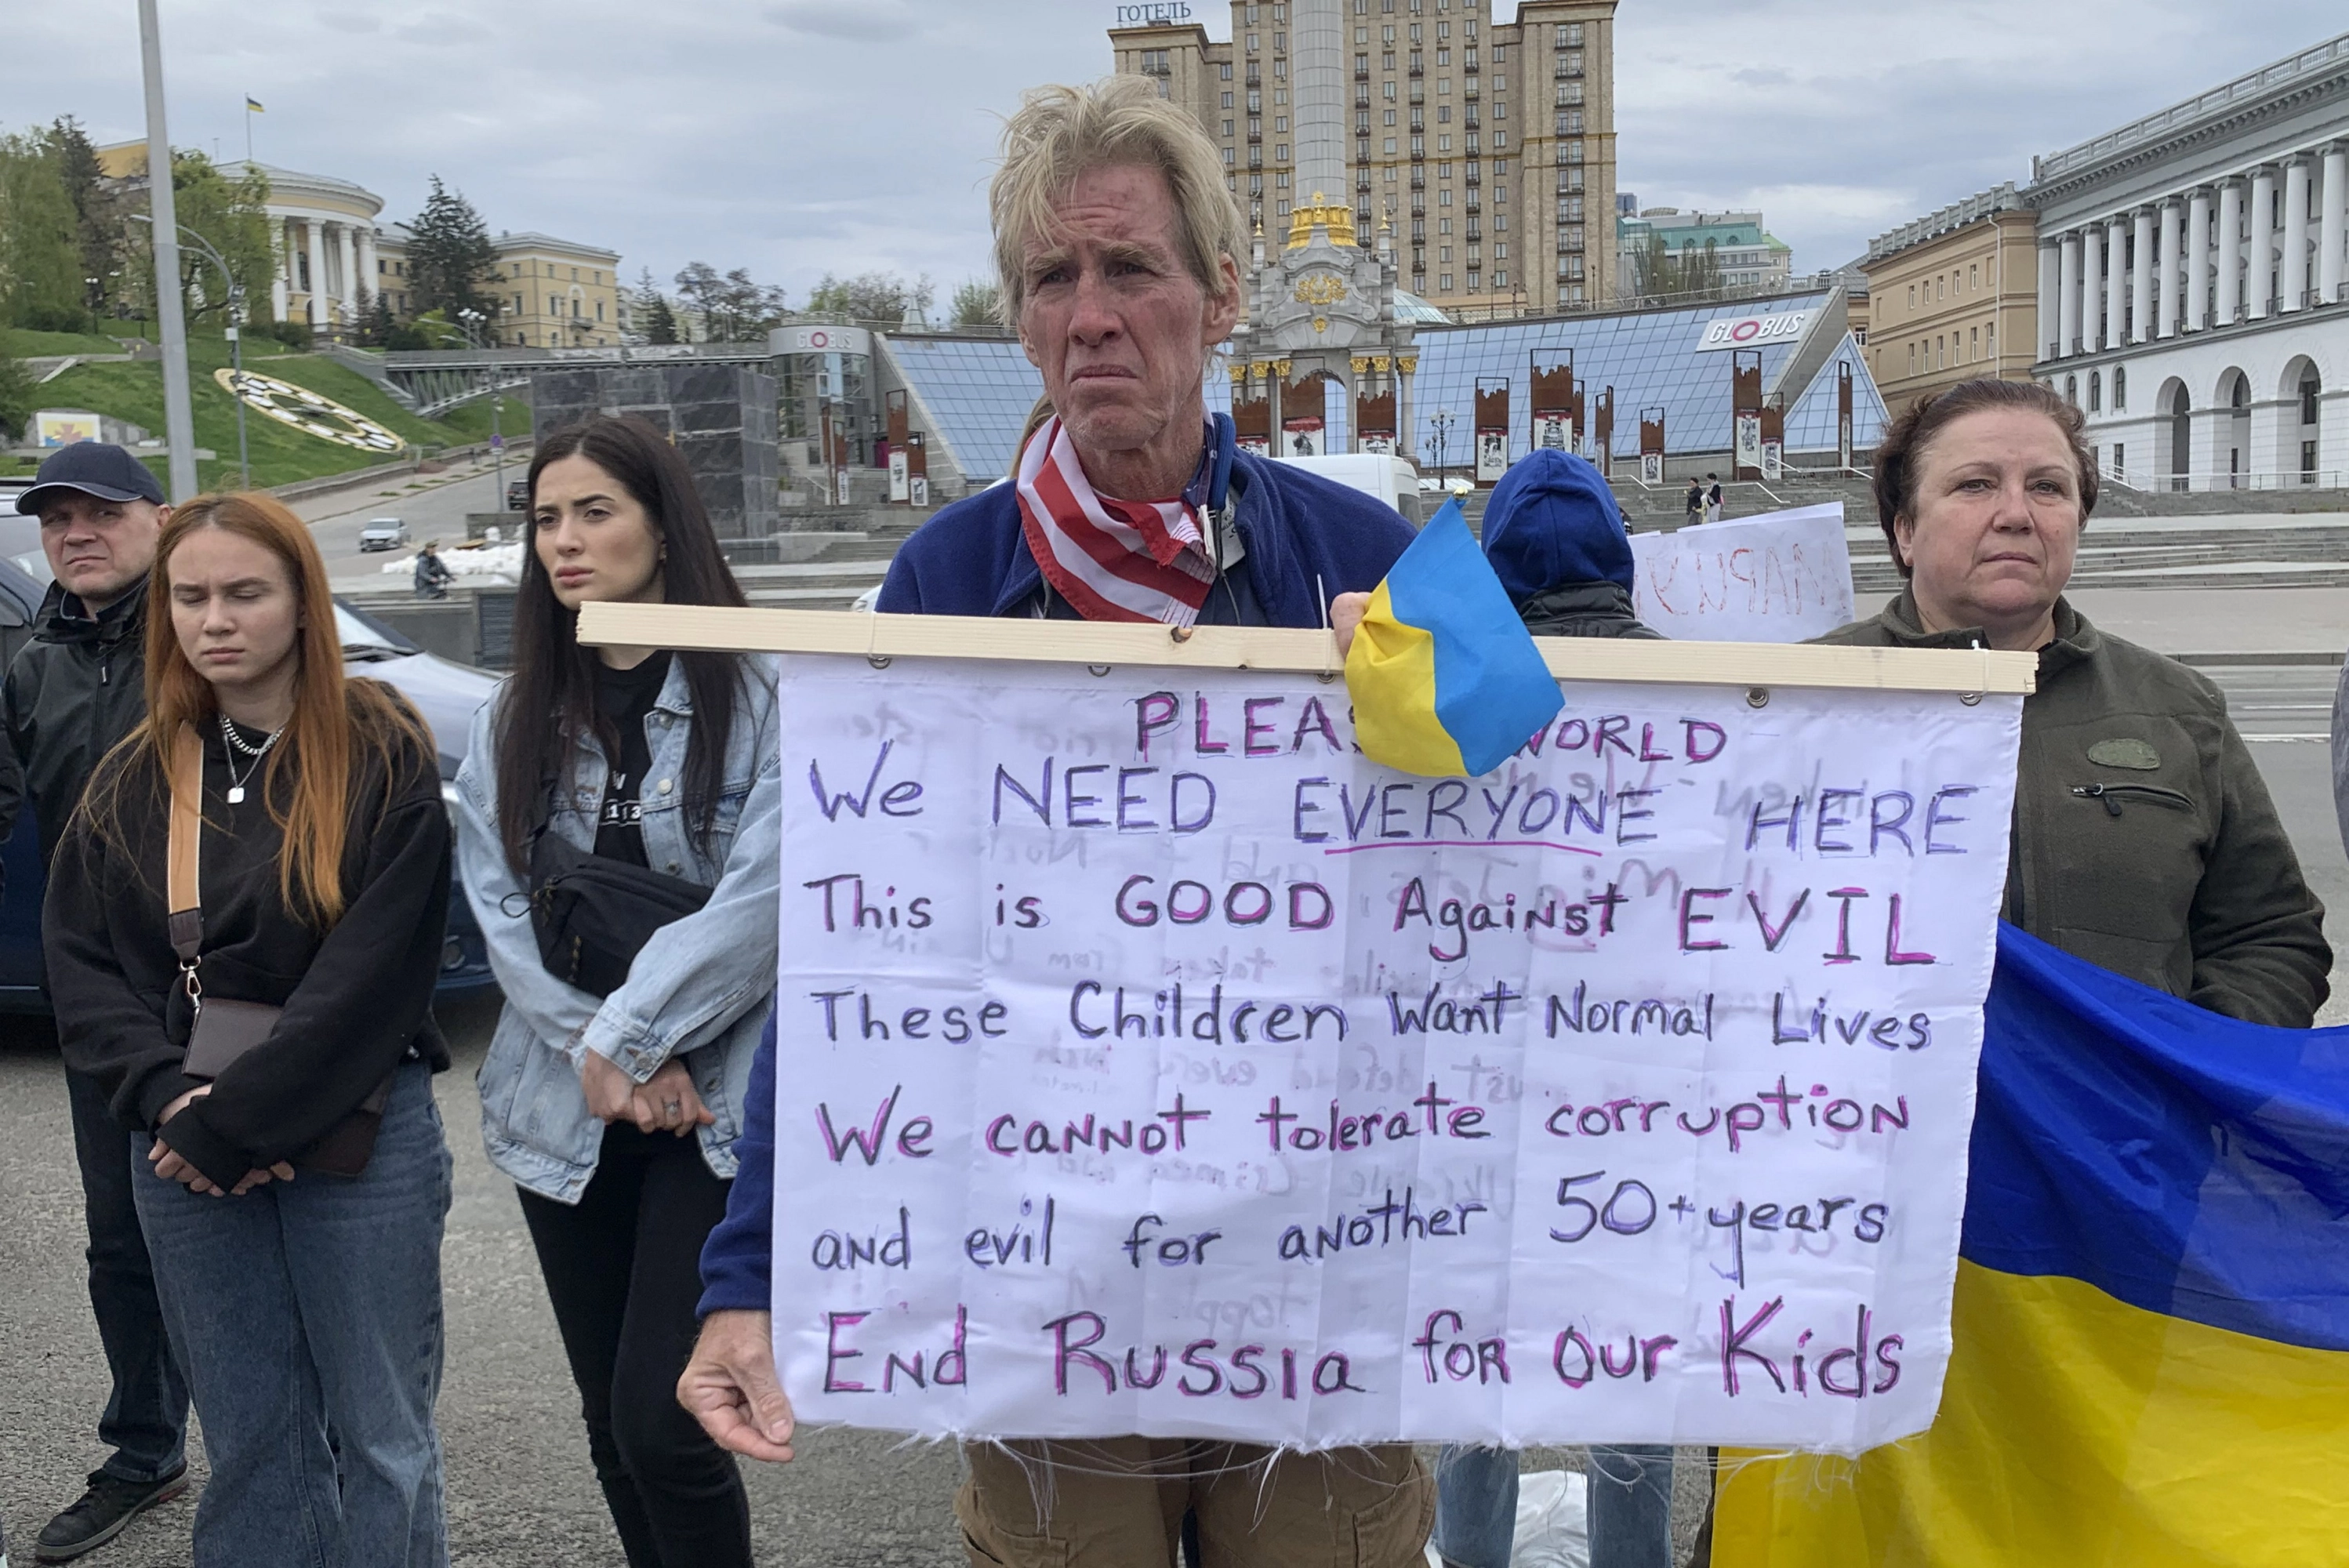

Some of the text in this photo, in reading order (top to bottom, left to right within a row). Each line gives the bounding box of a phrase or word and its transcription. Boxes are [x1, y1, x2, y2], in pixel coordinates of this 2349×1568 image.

[1116, 2, 1191, 22] ГОТЕЛЬ
[797, 332, 853, 349] GLOBUS
[1708, 314, 1805, 343] GLOBUS
[1135, 691, 1363, 759] PLEA
[809, 739, 924, 822] We
[990, 757, 1216, 835] NEED
[1294, 776, 1661, 848] EVERYONE
[1745, 784, 1980, 857] HERE
[804, 873, 1938, 967] This is GOOD Against EVIL
[809, 980, 1933, 1051] These Children Want Normal Lives
[815, 1084, 934, 1165] We
[1255, 1082, 1491, 1152] tolerate
[964, 1194, 1055, 1269] evil
[1122, 1212, 1223, 1268] for
[1720, 1294, 1902, 1398] Kids
